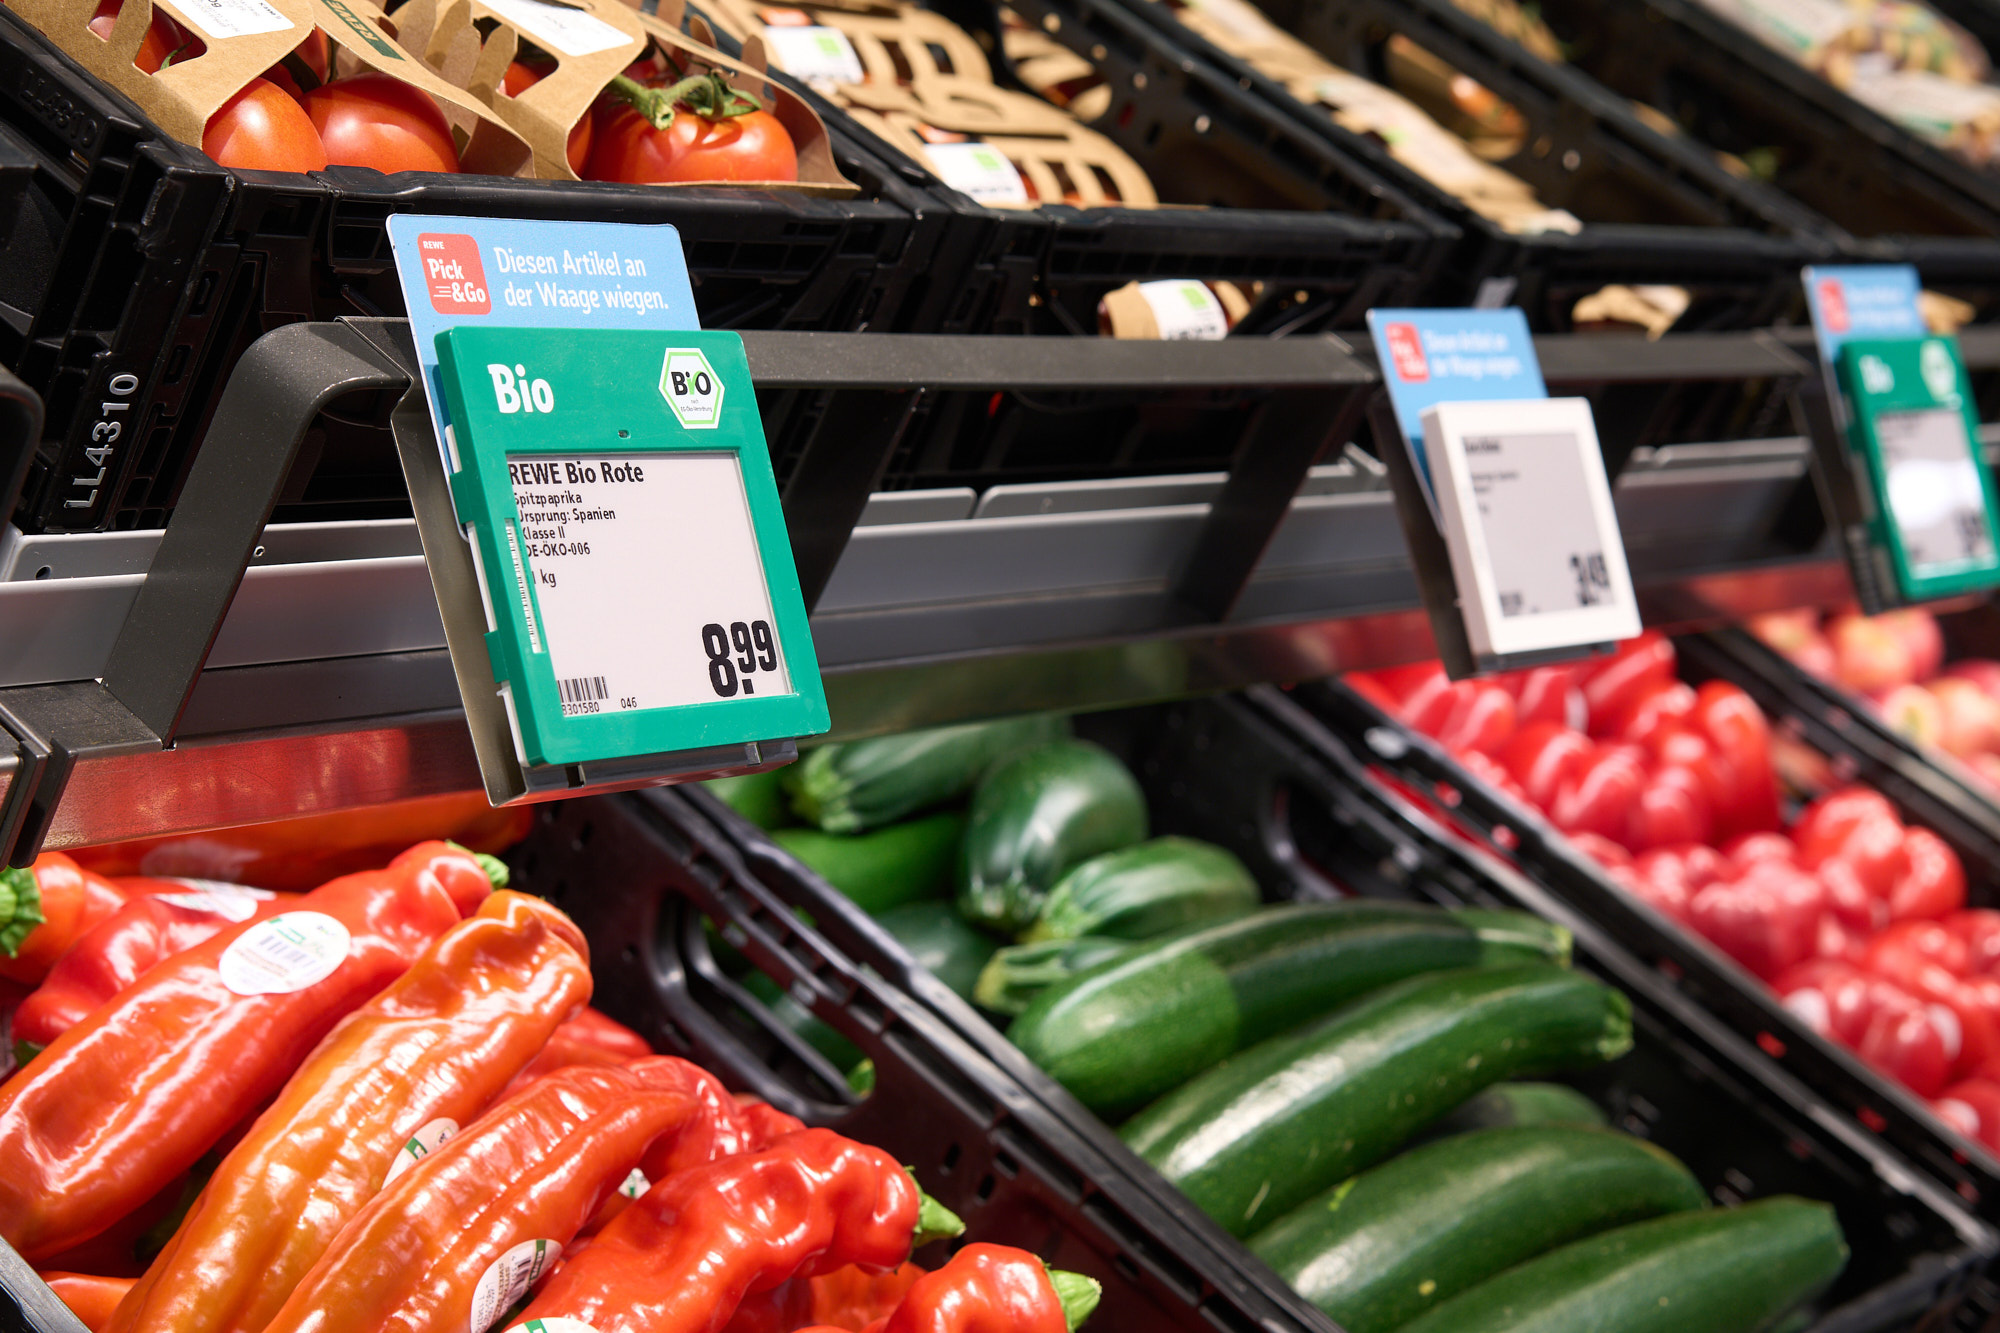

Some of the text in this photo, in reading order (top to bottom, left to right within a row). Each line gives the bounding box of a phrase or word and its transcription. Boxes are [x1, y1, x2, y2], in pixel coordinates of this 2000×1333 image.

[423, 240, 445, 250] REWE
[427, 258, 465, 280] Pick
[493, 247, 647, 277] Diesen Artikel an
[452, 282, 486, 303] &Go
[504, 281, 669, 316] der Waage wiegen.
[487, 363, 555, 414] Bio
[64, 374, 139, 508] LL4310
[507, 461, 644, 485] REWE Bio Rote
[572, 507, 616, 524] Spanien
[540, 568, 557, 588] kg
[701, 619, 778, 698] 8.99
[620, 696, 638, 709] 046
